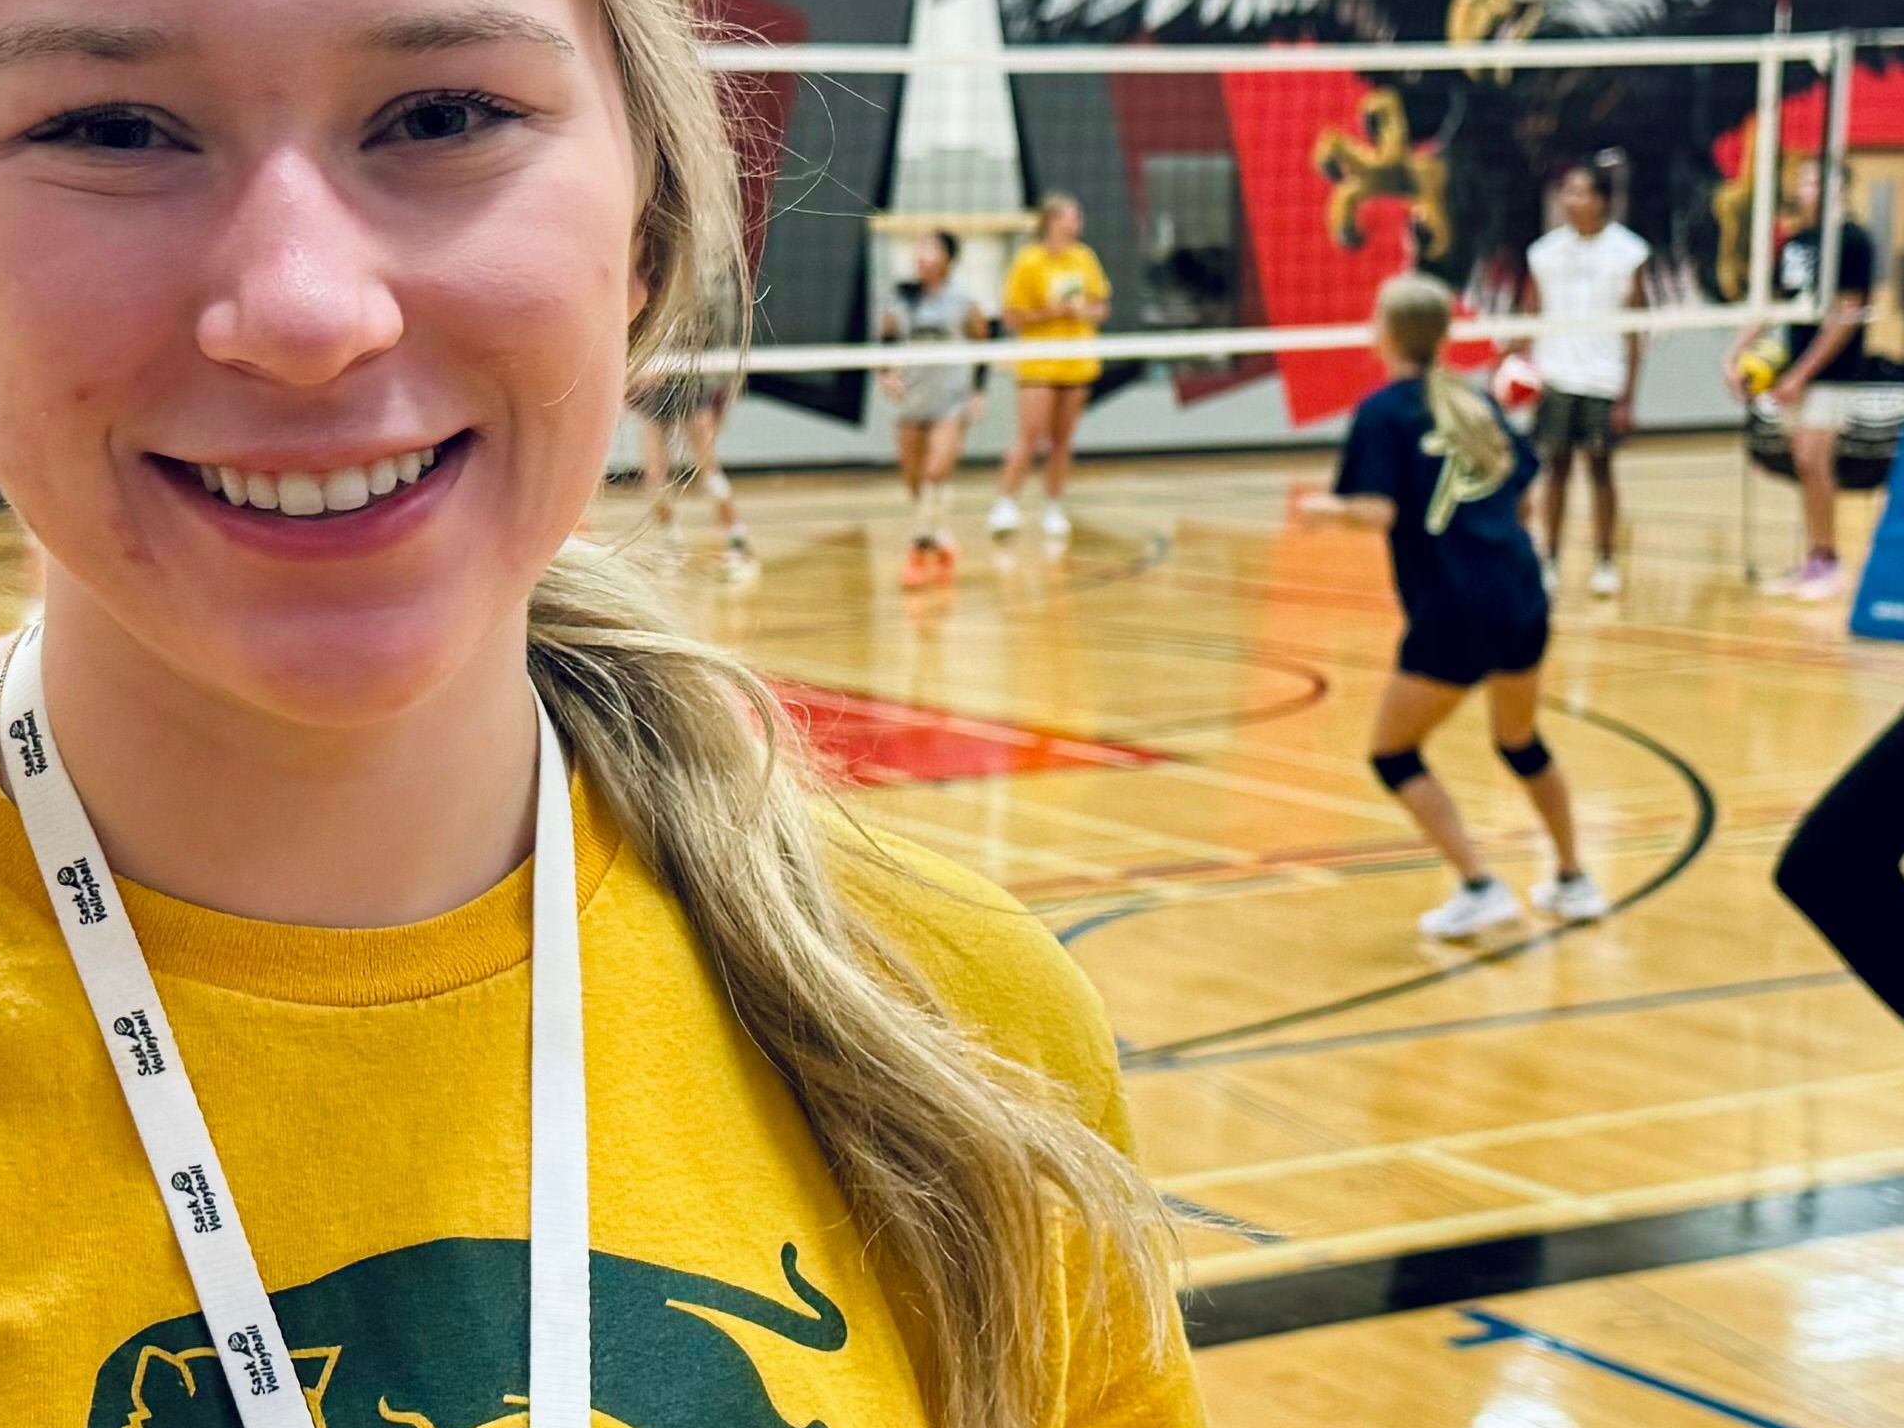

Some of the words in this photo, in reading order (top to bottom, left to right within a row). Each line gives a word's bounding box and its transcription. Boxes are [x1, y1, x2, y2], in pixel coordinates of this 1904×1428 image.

[20, 747, 37, 777] Sask
[23, 710, 48, 775] Volleyball
[72, 894, 94, 925] Sask
[74, 857, 108, 923] Volleyball
[130, 1044, 152, 1076] Sask
[131, 1009, 166, 1075] Volleyball
[187, 1199, 209, 1233] Sask
[188, 1164, 222, 1232] Volleyball
[244, 1361, 266, 1396] Sask
[245, 1325, 280, 1393] Volleyball
